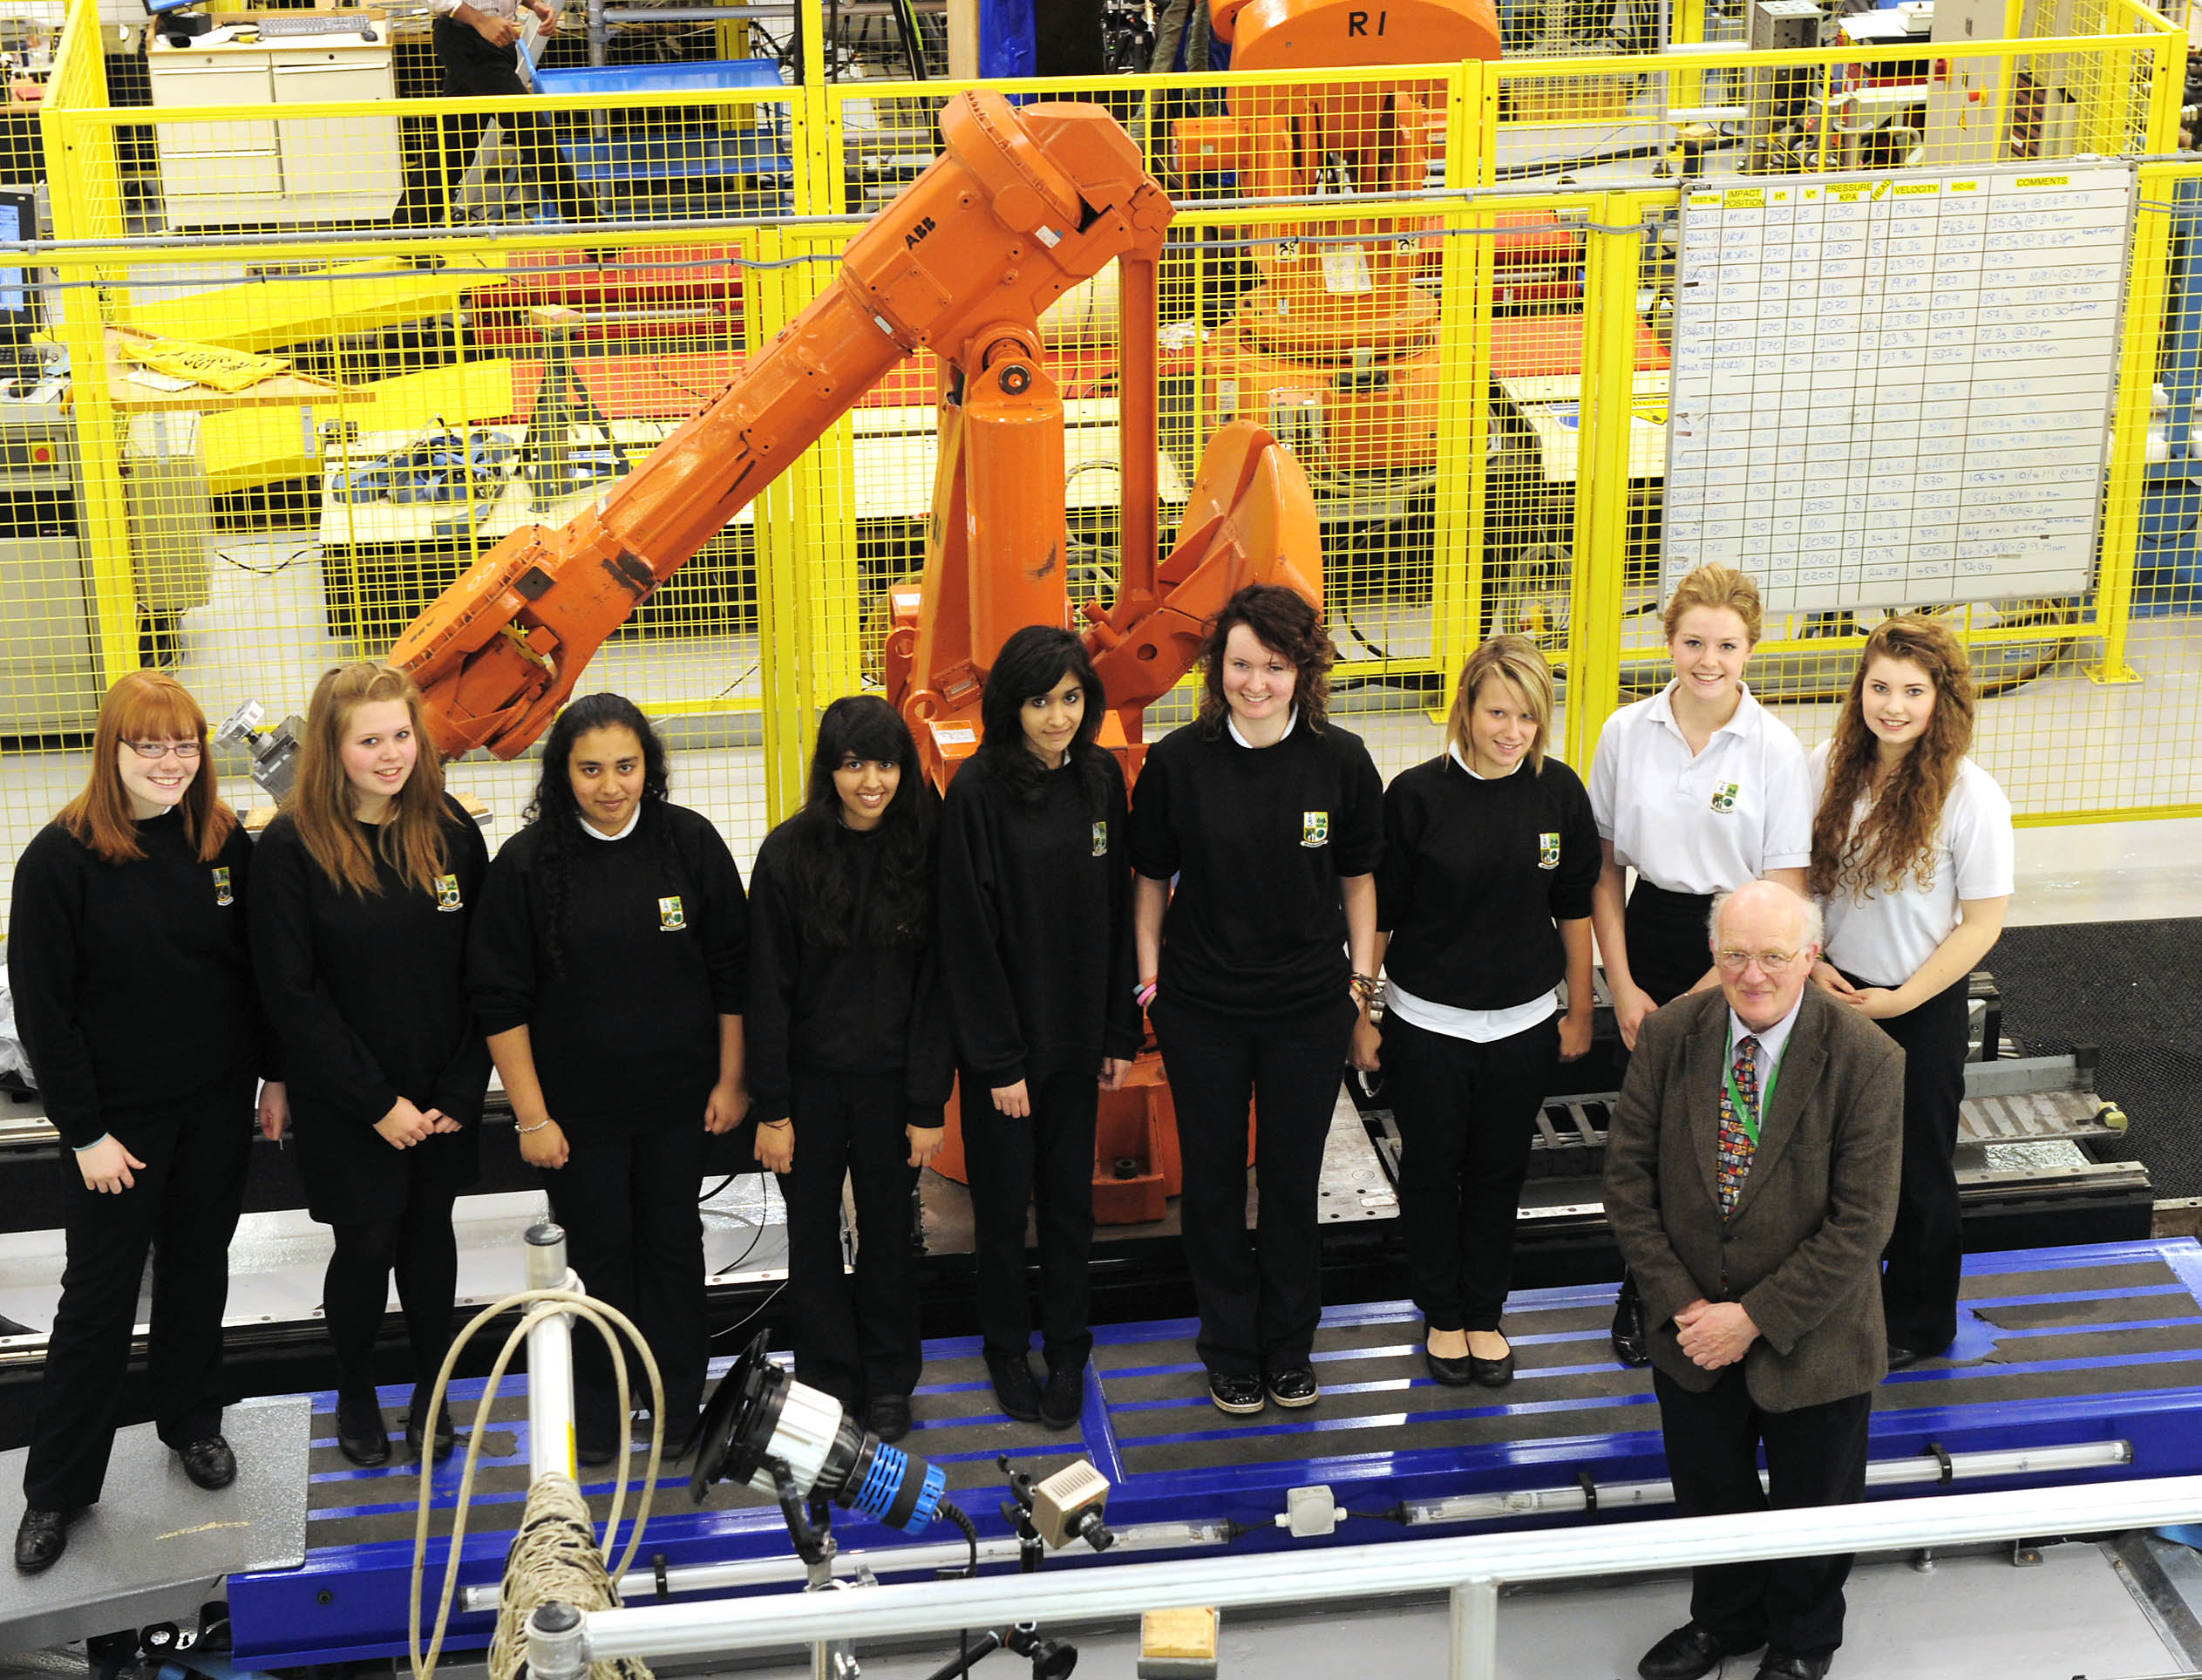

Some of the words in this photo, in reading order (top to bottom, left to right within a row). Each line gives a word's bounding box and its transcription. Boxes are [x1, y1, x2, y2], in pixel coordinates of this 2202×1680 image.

[2017, 177, 2067, 186] COMMENTS
[1872, 180, 1892, 200] HEAD
[1895, 185, 1938, 194] VELOCITY
[905, 216, 936, 250] ABB
[1760, 341, 1782, 350] 270
[1805, 501, 1833, 512] 2080
[1805, 536, 1836, 548] 2080
[1803, 554, 1836, 565] 2080
[1773, 574, 1791, 583] 50
